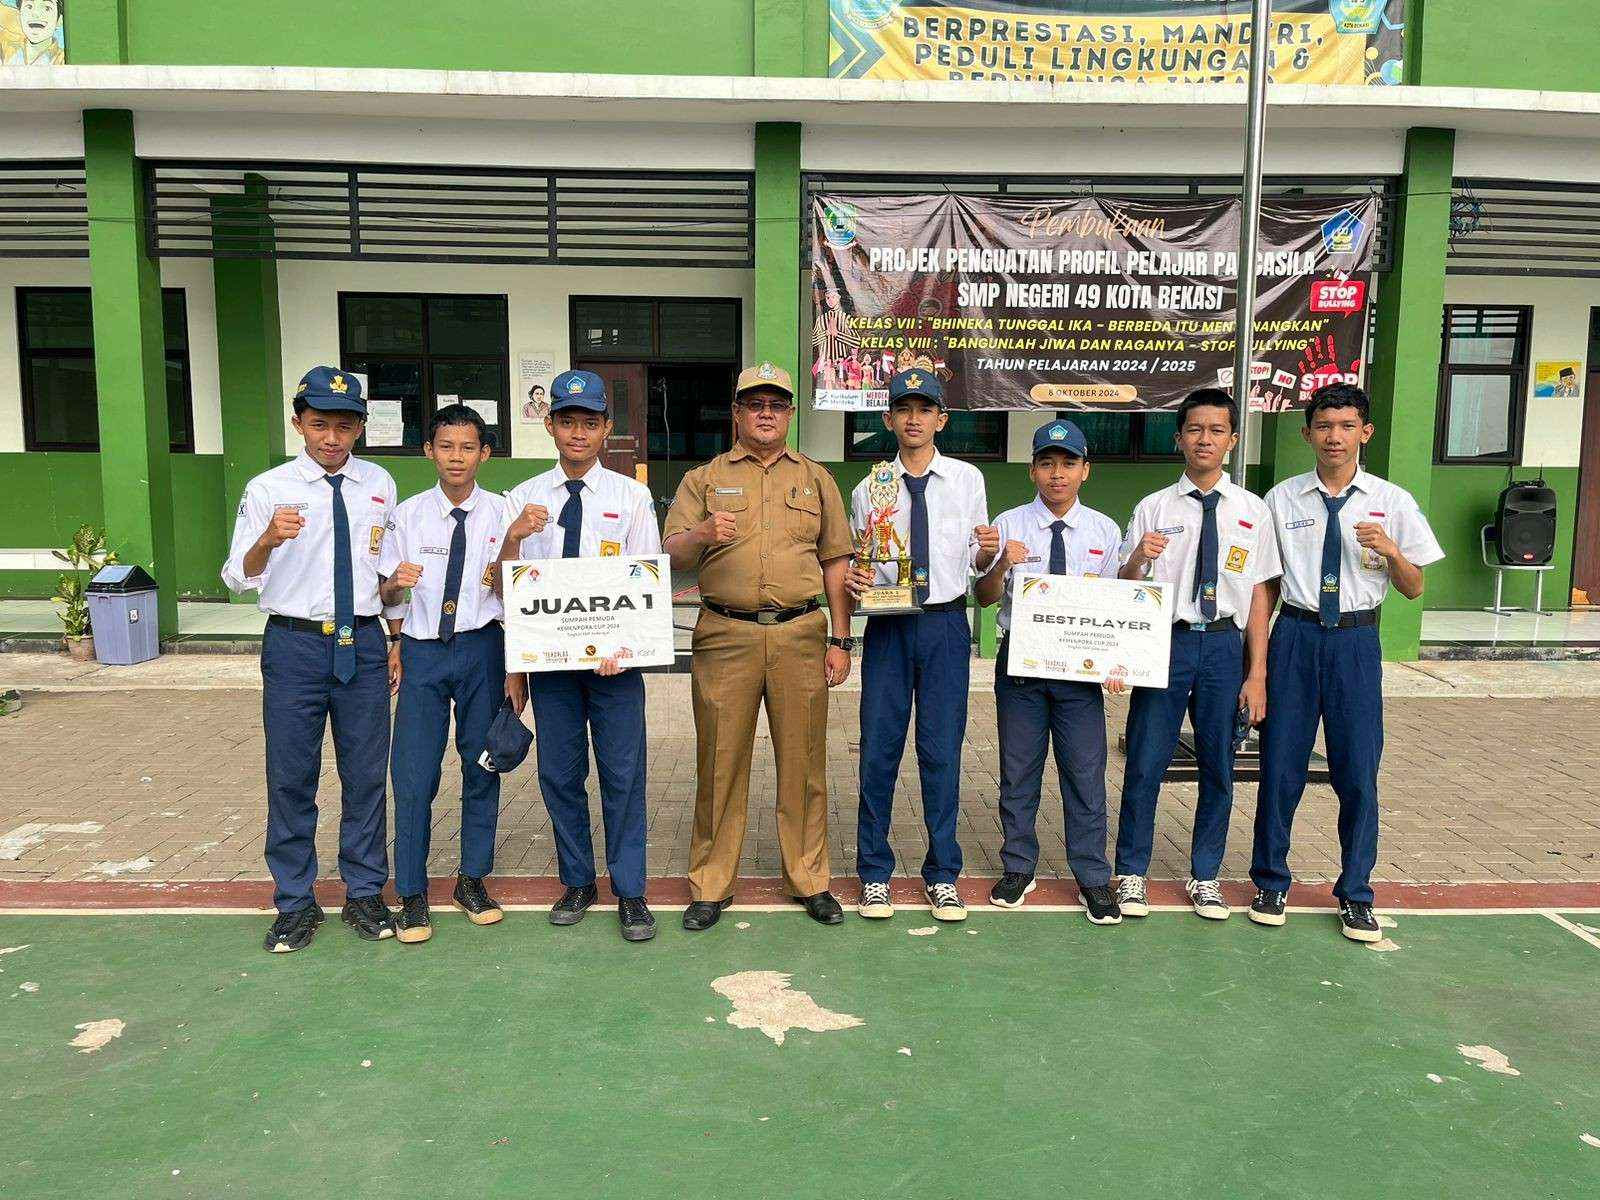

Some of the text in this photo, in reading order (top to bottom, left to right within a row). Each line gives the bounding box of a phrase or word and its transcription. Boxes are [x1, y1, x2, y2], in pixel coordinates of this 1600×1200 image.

[903, 16, 1323, 46] BERPRESTASI, MANDRI,
[915, 43, 1034, 70] PEDULI
[1292, 47, 1310, 70] &
[1021, 206, 1165, 241] Pembukaan
[870, 247, 1315, 276] PROJEK PENGUATAN PROFIL PELAJAR PACASILA
[957, 282, 1223, 310] SMP NEGERI 49 KOTA BEKASI
[1318, 286, 1358, 300] STOP
[850, 318, 893, 330] KELAS
[998, 319, 1064, 331] TUNGGAL
[1069, 320, 1092, 331] IKA
[1107, 320, 1171, 332] BERBEDA
[1176, 321, 1198, 333] ITU
[860, 338, 904, 349] KELAS
[1039, 339, 1076, 351] JIWA
[1080, 339, 1109, 351] DAN
[1114, 339, 1185, 351] RAGANYA
[977, 357, 1196, 374] TAHUN PELAJARAN 2024 / 2025
[1278, 374, 1293, 385] NO
[1300, 373, 1359, 391] STOP
[866, 391, 888, 399] MERDEK
[1056, 388, 1097, 397] OKTOBER
[1099, 388, 1119, 397] 2024
[866, 399, 888, 407] BELAJA
[520, 593, 653, 616] JUARA 1
[1032, 613, 1151, 631] BEST PLAYER
